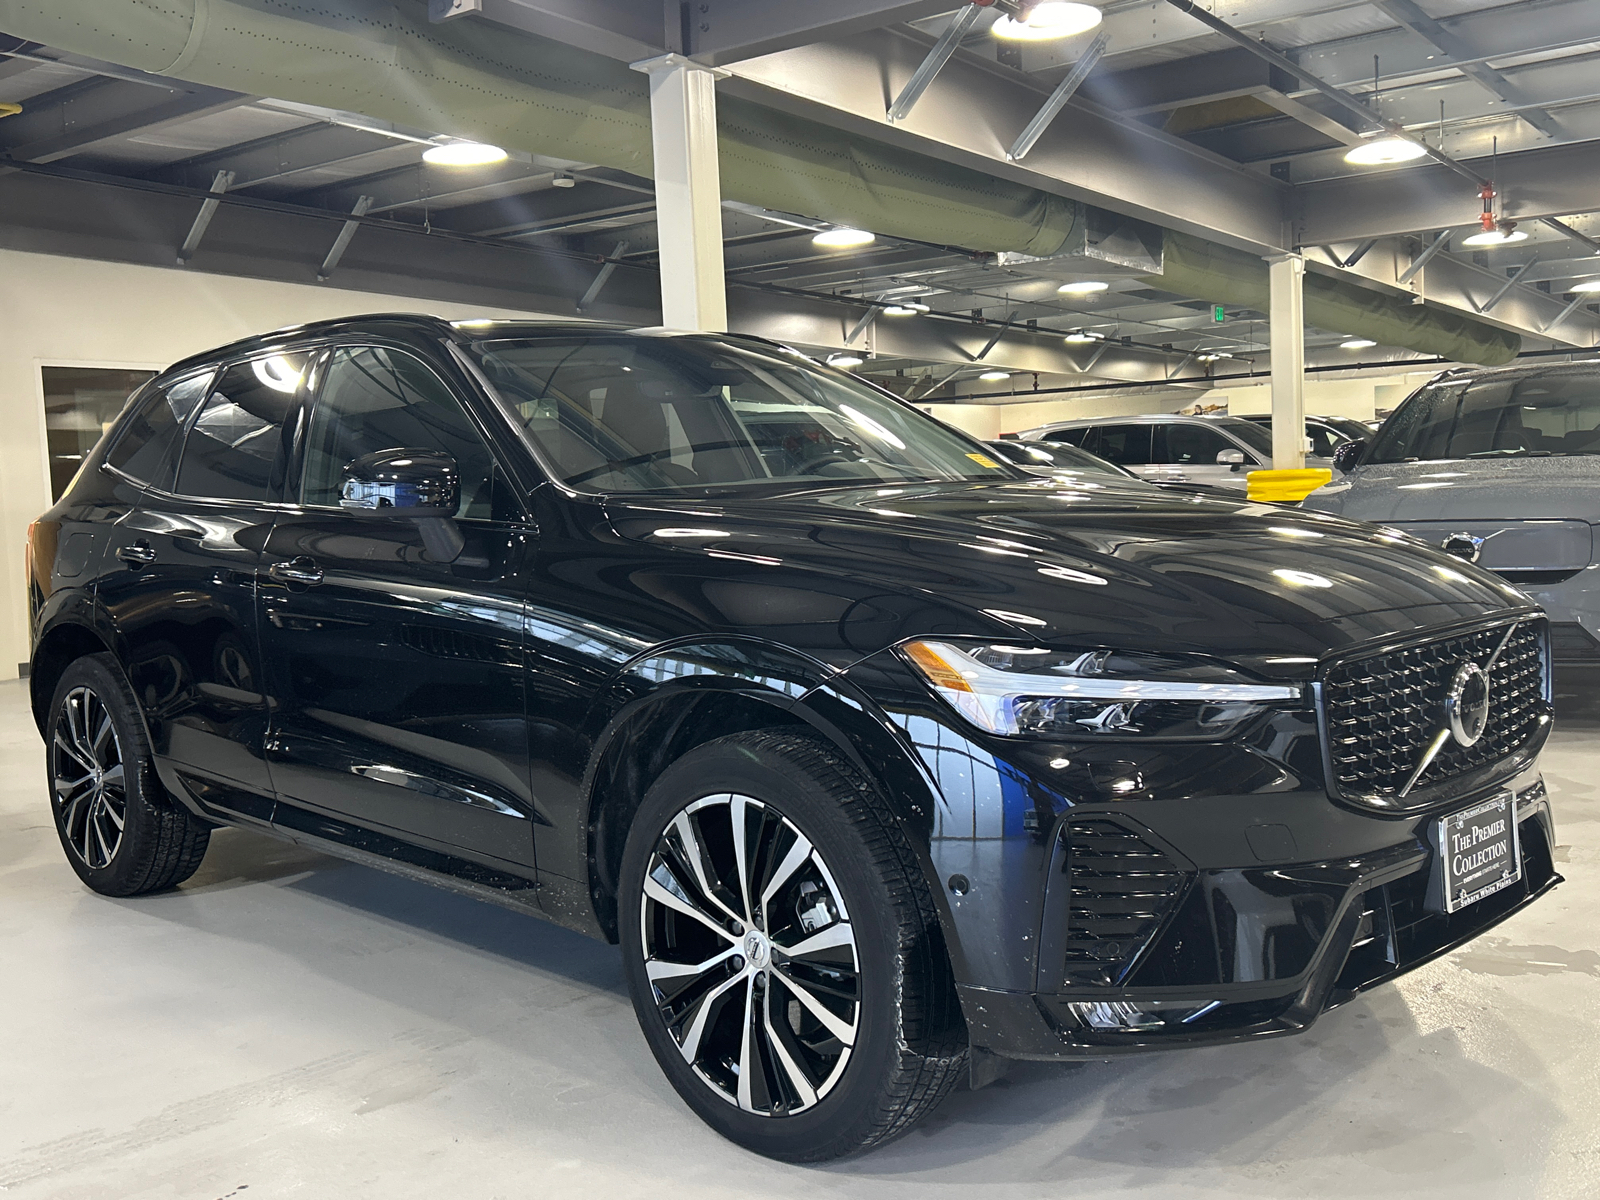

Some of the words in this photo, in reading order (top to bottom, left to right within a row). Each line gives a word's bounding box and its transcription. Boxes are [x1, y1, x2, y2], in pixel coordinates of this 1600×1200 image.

[1453, 840, 1507, 876] COLLECTION
[1460, 893, 1480, 907] Subaru
[1479, 886, 1496, 897] White
[1496, 878, 1512, 890] Plains
